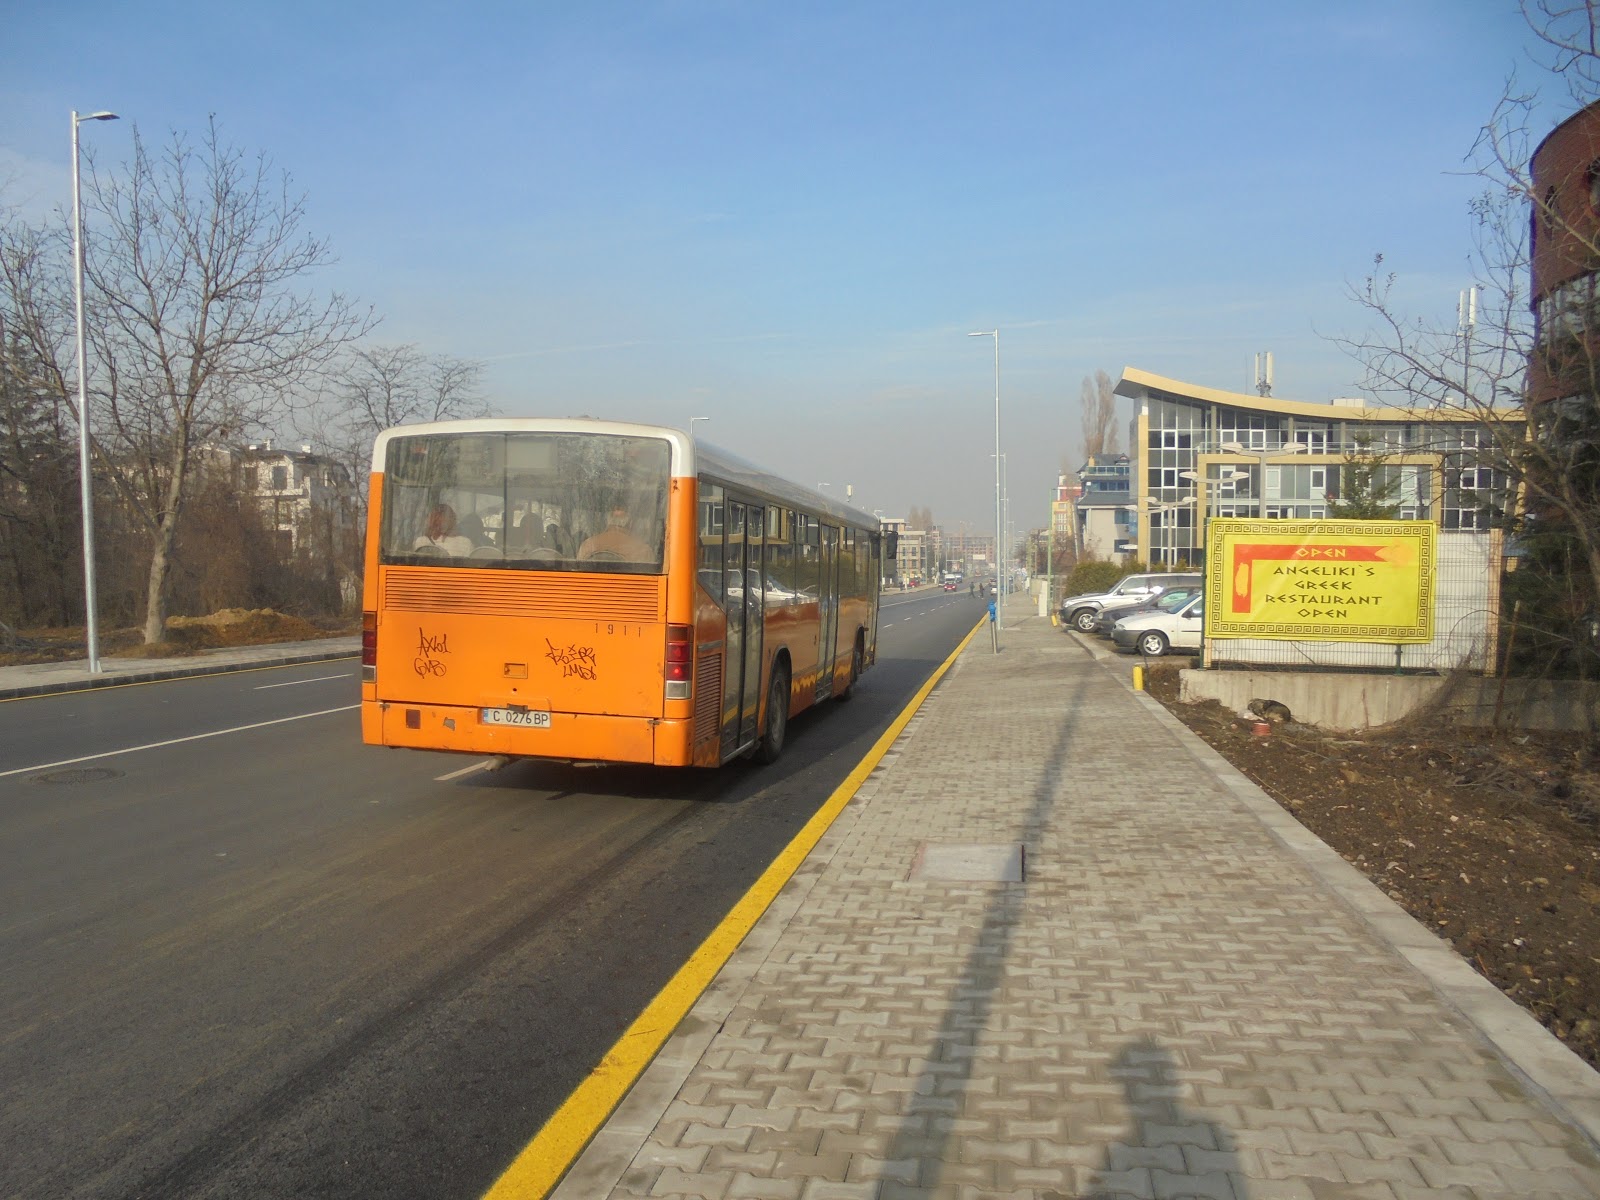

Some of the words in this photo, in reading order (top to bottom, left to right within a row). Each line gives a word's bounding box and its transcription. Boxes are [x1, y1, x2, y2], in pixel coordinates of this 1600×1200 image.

[1295, 547, 1346, 558] OPEN
[1294, 580, 1352, 590] GREEK
[1265, 594, 1383, 605] RESTAURANT
[1297, 608, 1347, 618] OPEN
[493, 710, 500, 722] C
[505, 711, 532, 724] 0276
[534, 713, 549, 725] BP
